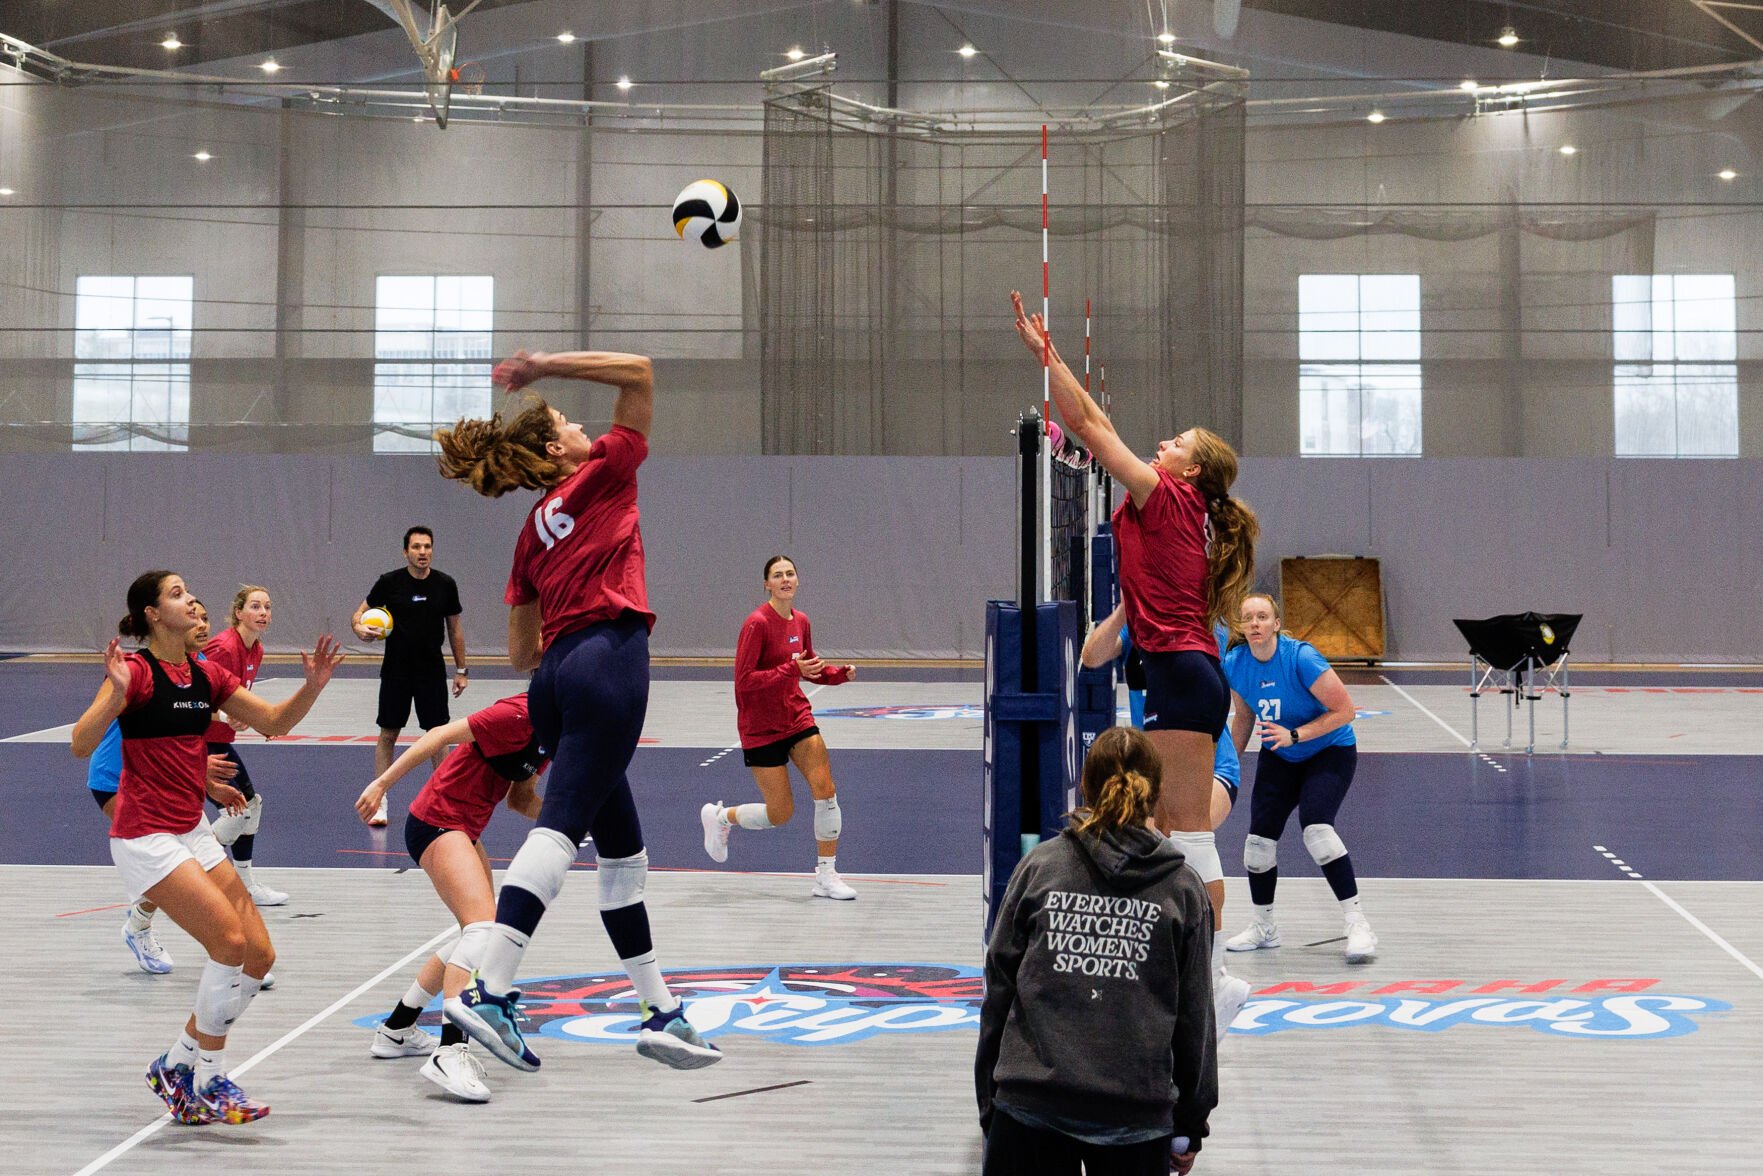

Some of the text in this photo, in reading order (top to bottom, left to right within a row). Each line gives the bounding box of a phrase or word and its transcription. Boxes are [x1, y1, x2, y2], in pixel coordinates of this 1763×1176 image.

[534, 496, 575, 551] 16
[1258, 698, 1281, 721] 27
[1044, 890, 1162, 922] EVERYONE
[1048, 911, 1154, 941] WATCHES
[1046, 931, 1150, 962] WOMEN'S
[1053, 953, 1139, 980] SPORTS.
[1248, 978, 1662, 995] MAHA
